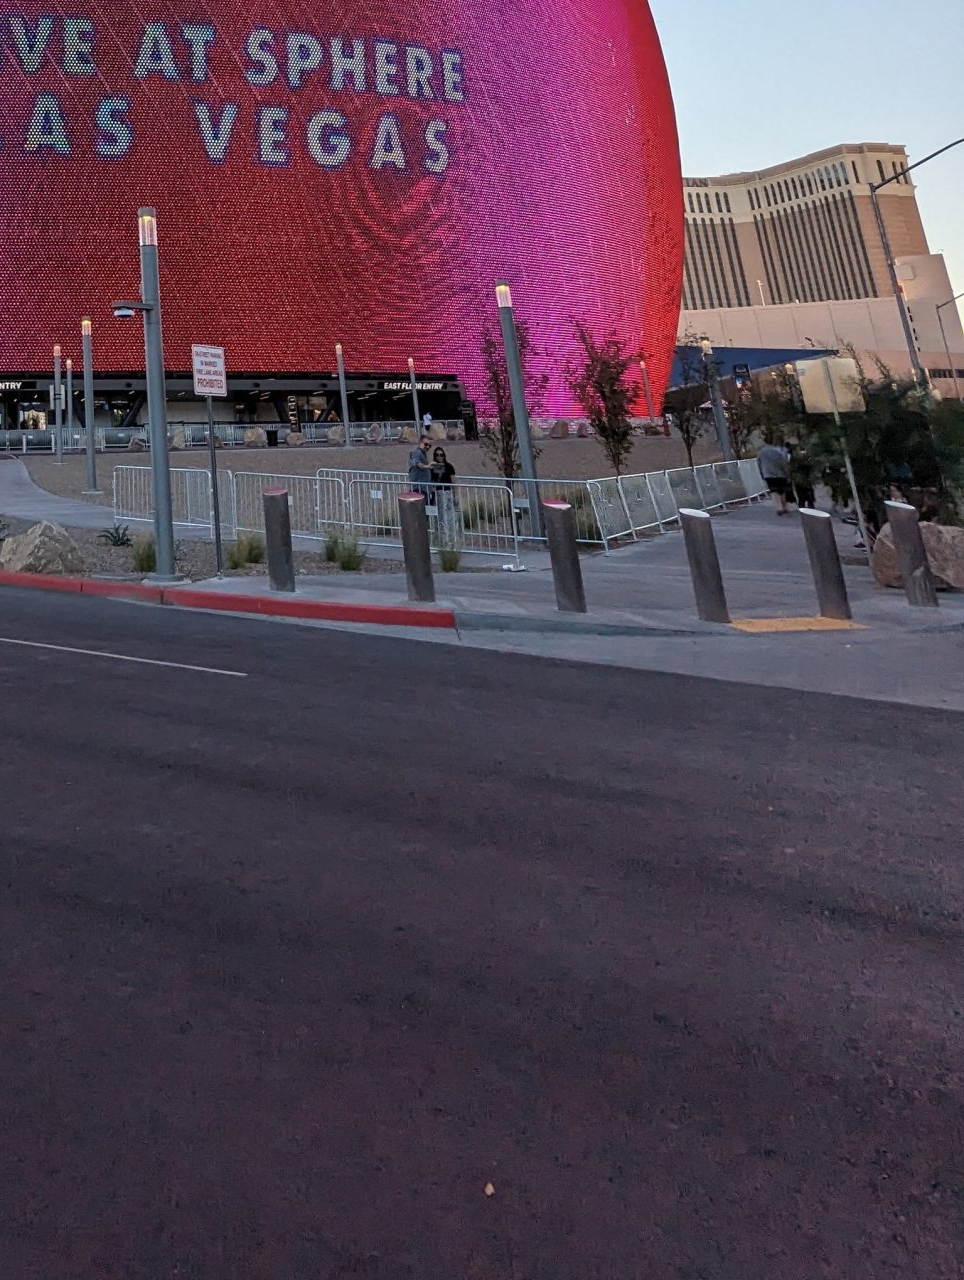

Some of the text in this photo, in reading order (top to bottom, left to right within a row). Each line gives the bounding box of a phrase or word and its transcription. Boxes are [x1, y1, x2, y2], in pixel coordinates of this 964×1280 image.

[135, 20, 215, 81] AT
[244, 25, 465, 101] SPHERE
[191, 98, 450, 174] VEGAS
[383, 382, 401, 390] EAST
[422, 382, 443, 390] ENTRY
